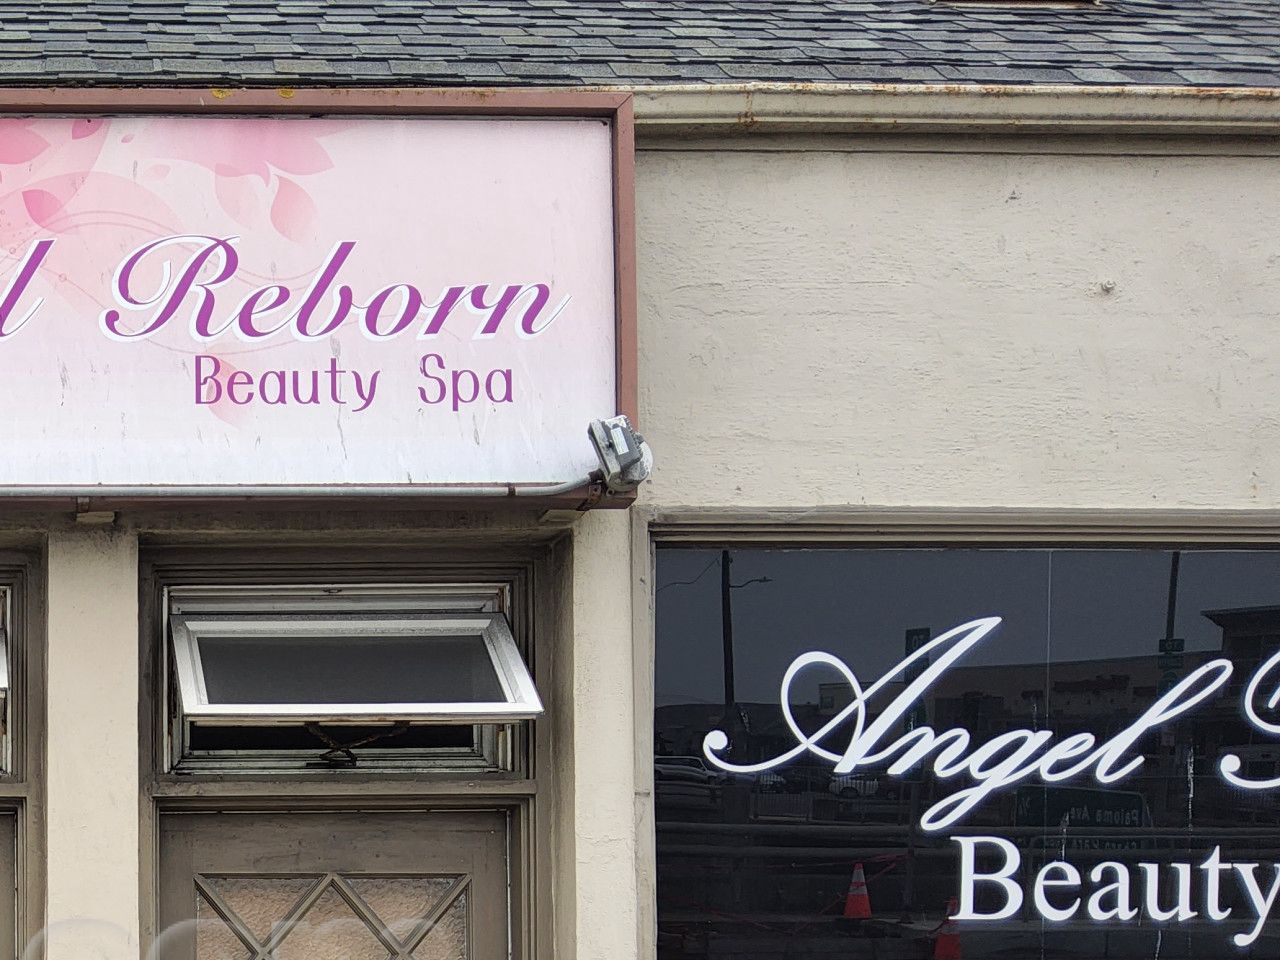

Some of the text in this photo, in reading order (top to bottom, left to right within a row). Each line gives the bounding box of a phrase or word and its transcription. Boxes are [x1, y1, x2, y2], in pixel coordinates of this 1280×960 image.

[98, 233, 572, 342] Reborn
[195, 353, 513, 412] Beauty Spa
[703, 616, 1234, 831] Angel
[949, 836, 1280, 947] Beauty
